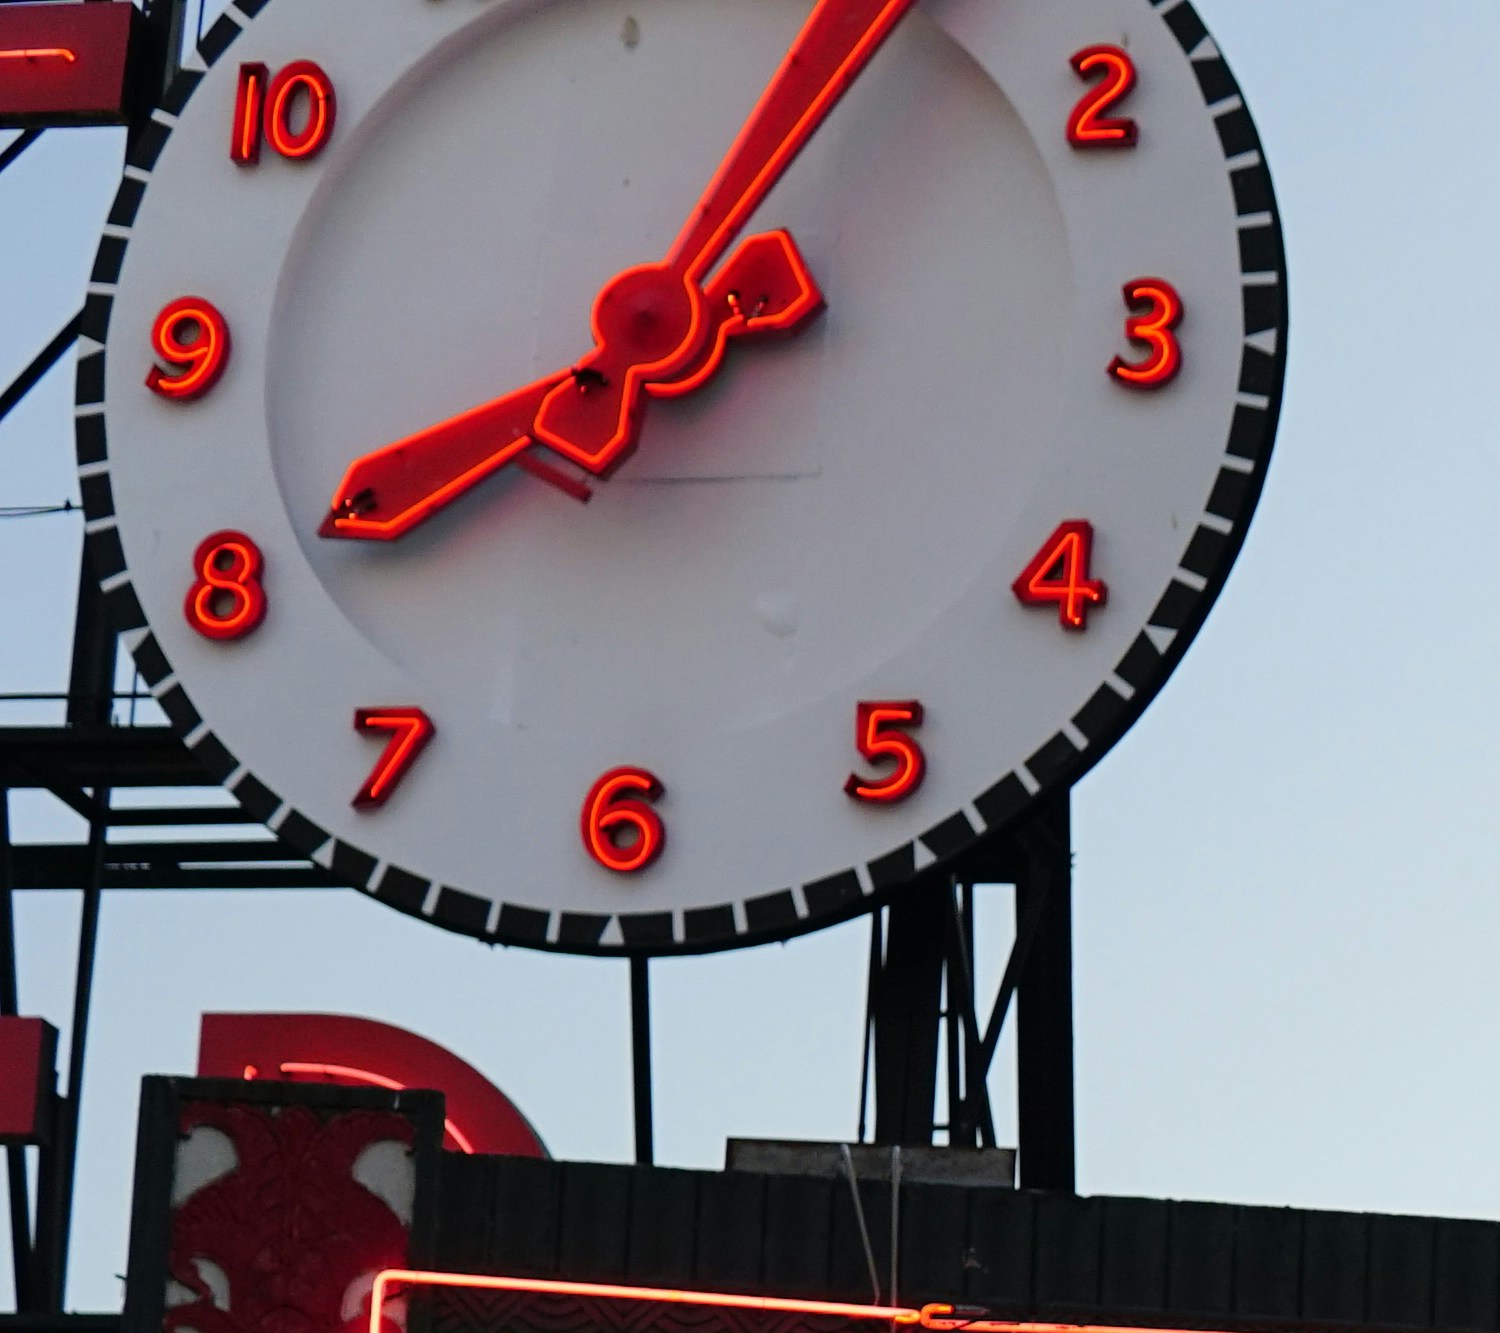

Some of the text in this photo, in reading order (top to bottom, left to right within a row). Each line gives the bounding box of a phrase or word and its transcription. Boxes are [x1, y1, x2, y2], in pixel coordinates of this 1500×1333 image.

[229, 60, 338, 166] 10
[1067, 44, 1139, 149] 2
[145, 295, 232, 401] 9
[1107, 277, 1185, 390] 3
[183, 530, 268, 641] 8
[1012, 519, 1108, 630] 4
[351, 706, 436, 811] 7
[843, 699, 927, 805] 5
[580, 766, 667, 873] 6
